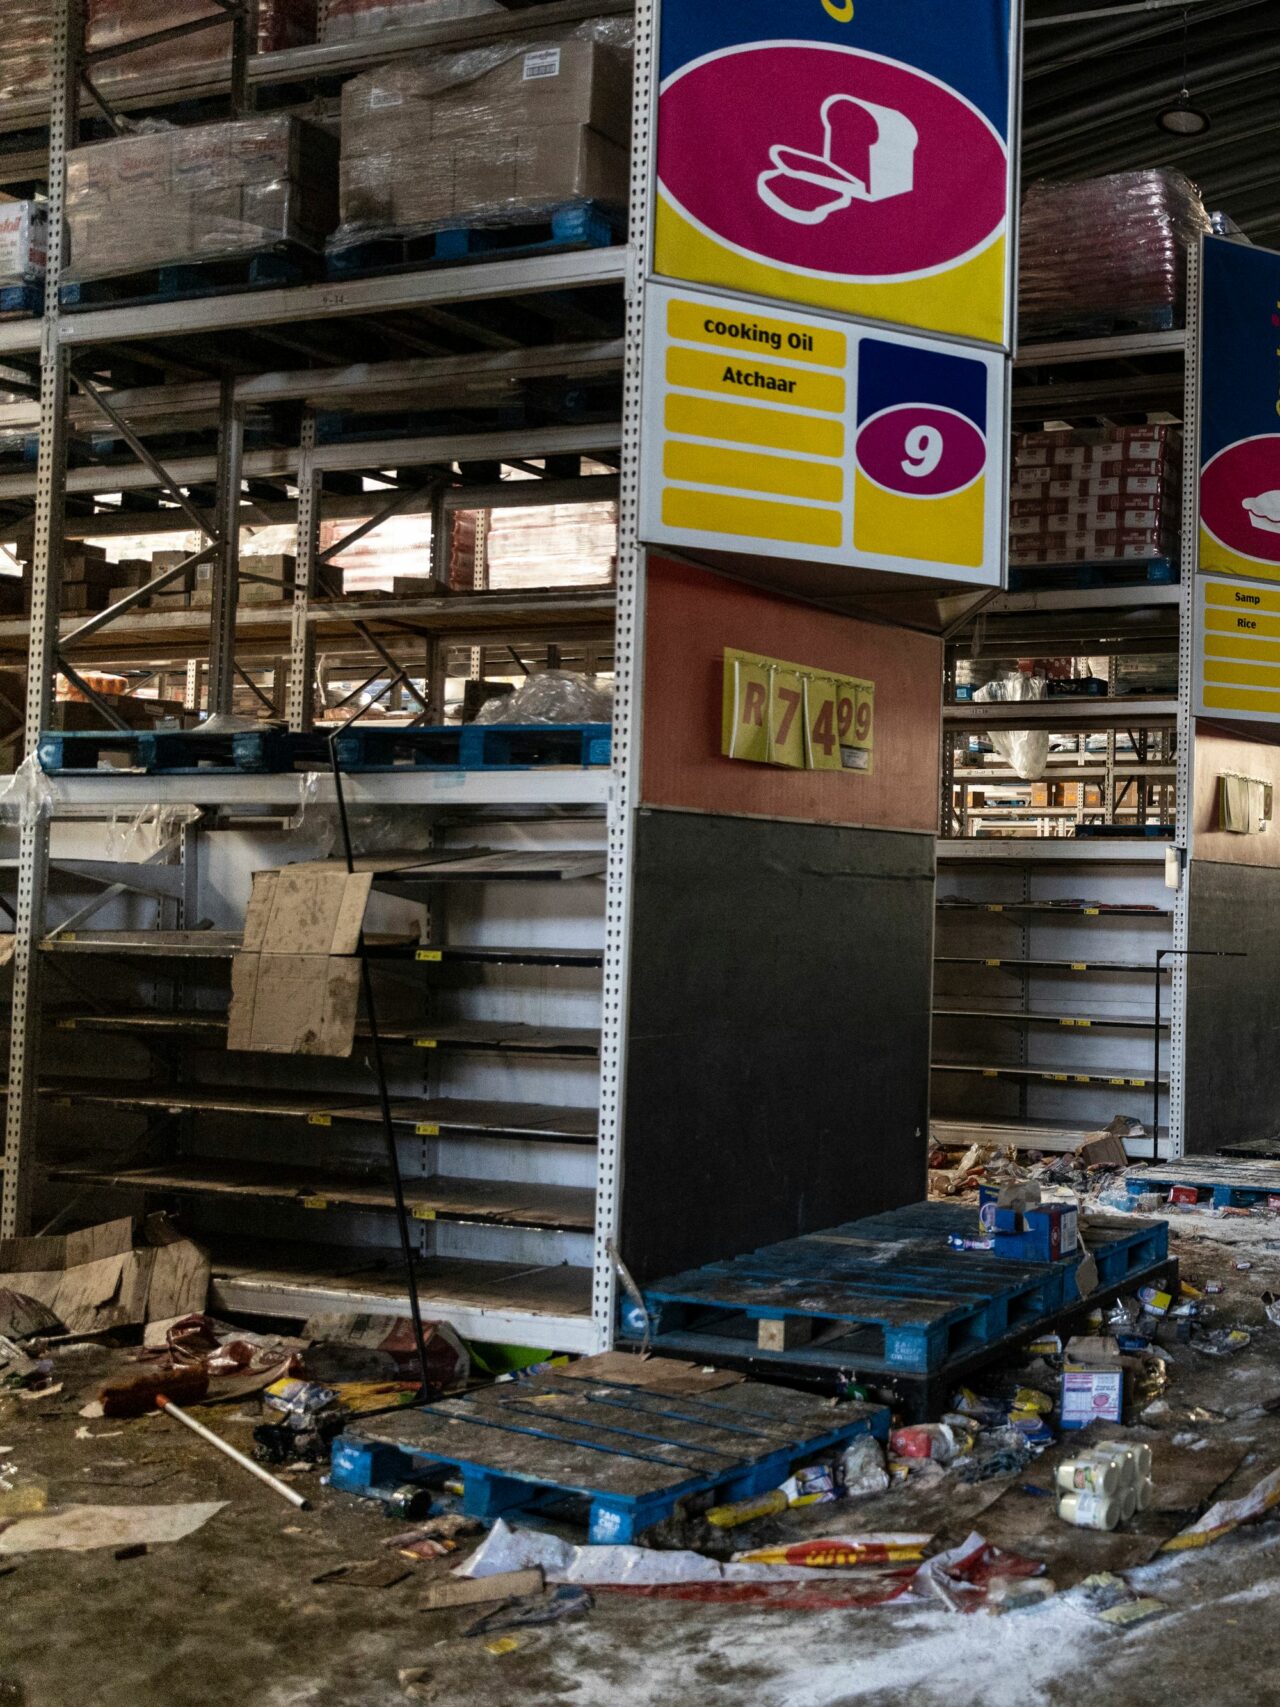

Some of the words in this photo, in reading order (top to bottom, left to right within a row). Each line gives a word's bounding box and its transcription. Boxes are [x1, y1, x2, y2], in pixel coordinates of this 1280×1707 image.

[787, 333, 813, 352] Oil
[722, 366, 797, 393] Atchaar
[900, 424, 944, 478] 9
[1235, 592, 1260, 605] Samp
[1237, 618, 1257, 629] Rice
